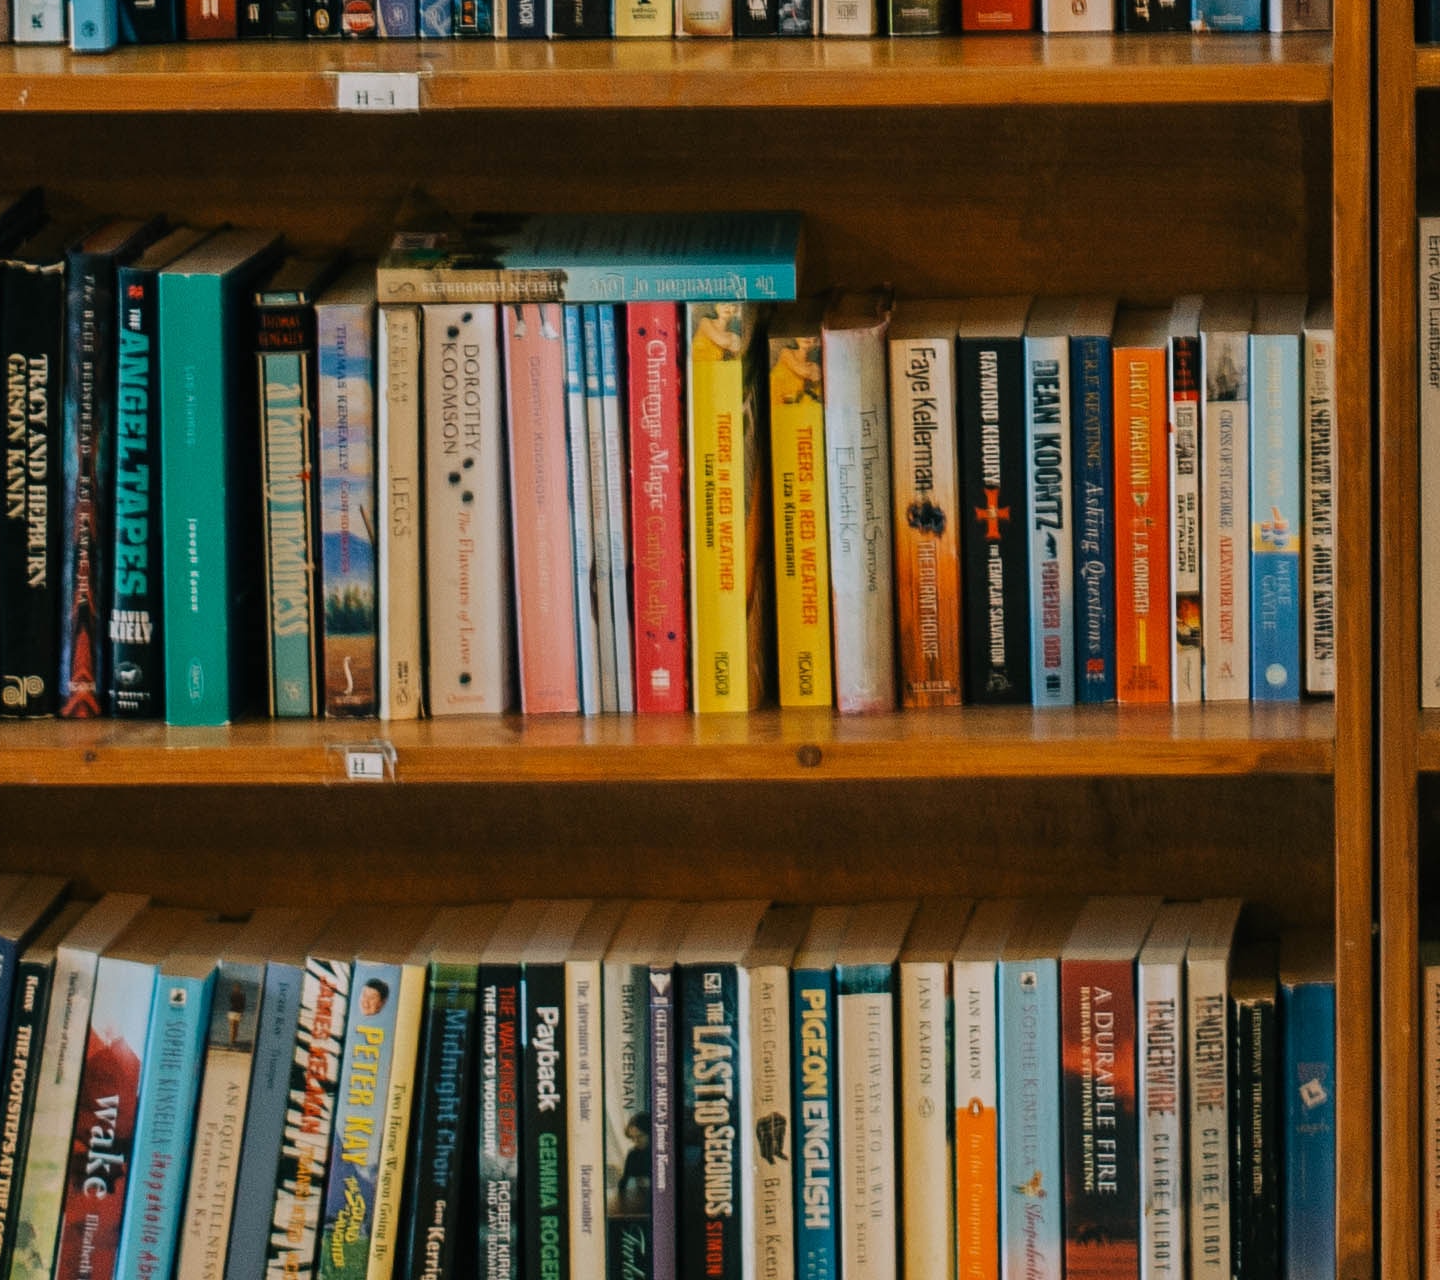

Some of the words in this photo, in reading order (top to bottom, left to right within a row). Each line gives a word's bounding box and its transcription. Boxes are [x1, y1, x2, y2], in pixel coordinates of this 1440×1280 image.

[116, 330, 149, 459] ANGEL
[441, 341, 459, 455] KOOMSON
[463, 343, 481, 452] DOROTHY
[116, 465, 149, 597] TAPES
[532, 1006, 559, 1111] Payback
[802, 989, 828, 1098] PIGEON
[83, 1094, 123, 1199] wake
[804, 1101, 829, 1230] ENGLISH
